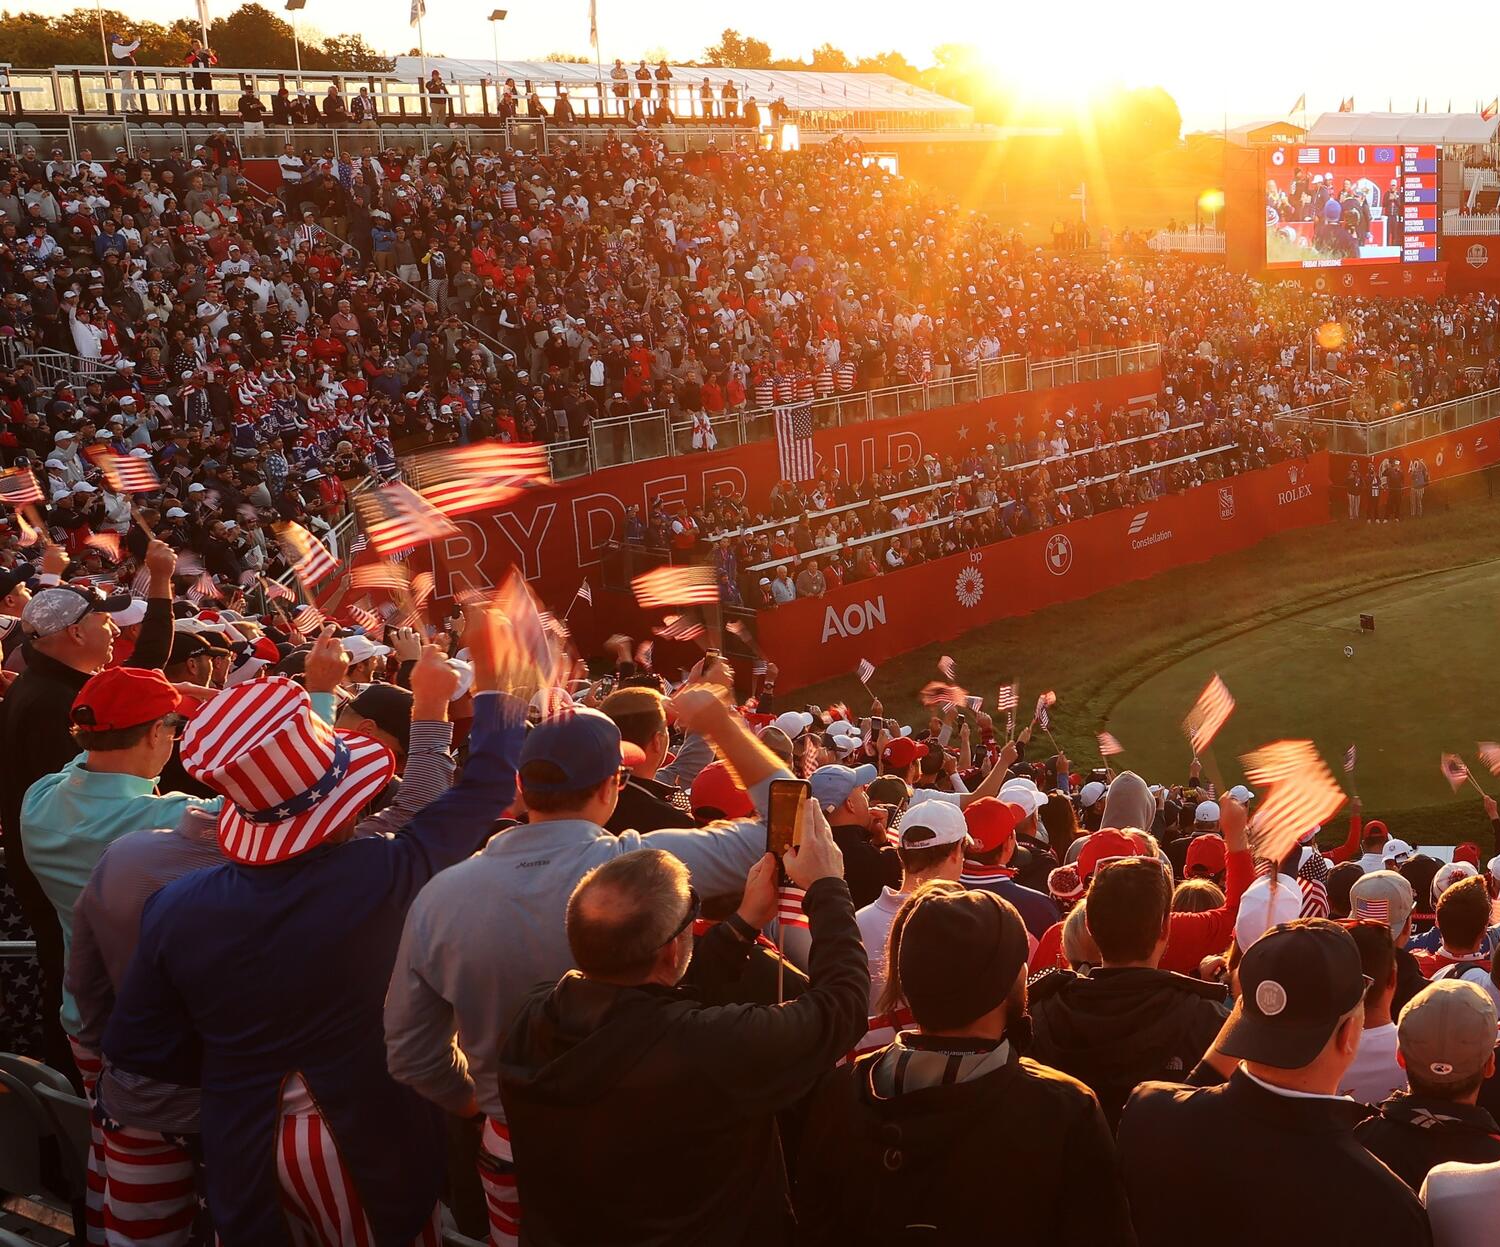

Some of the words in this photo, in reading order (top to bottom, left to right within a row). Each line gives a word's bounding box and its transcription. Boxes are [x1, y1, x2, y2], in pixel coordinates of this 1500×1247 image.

[1329, 147, 1335, 164] 0
[1359, 147, 1365, 164] 0
[1277, 484, 1312, 505] ROLEX
[430, 466, 747, 600] RYDER
[1131, 529, 1172, 550] Constellation
[969, 551, 983, 564] bp
[821, 595, 887, 643] AON
